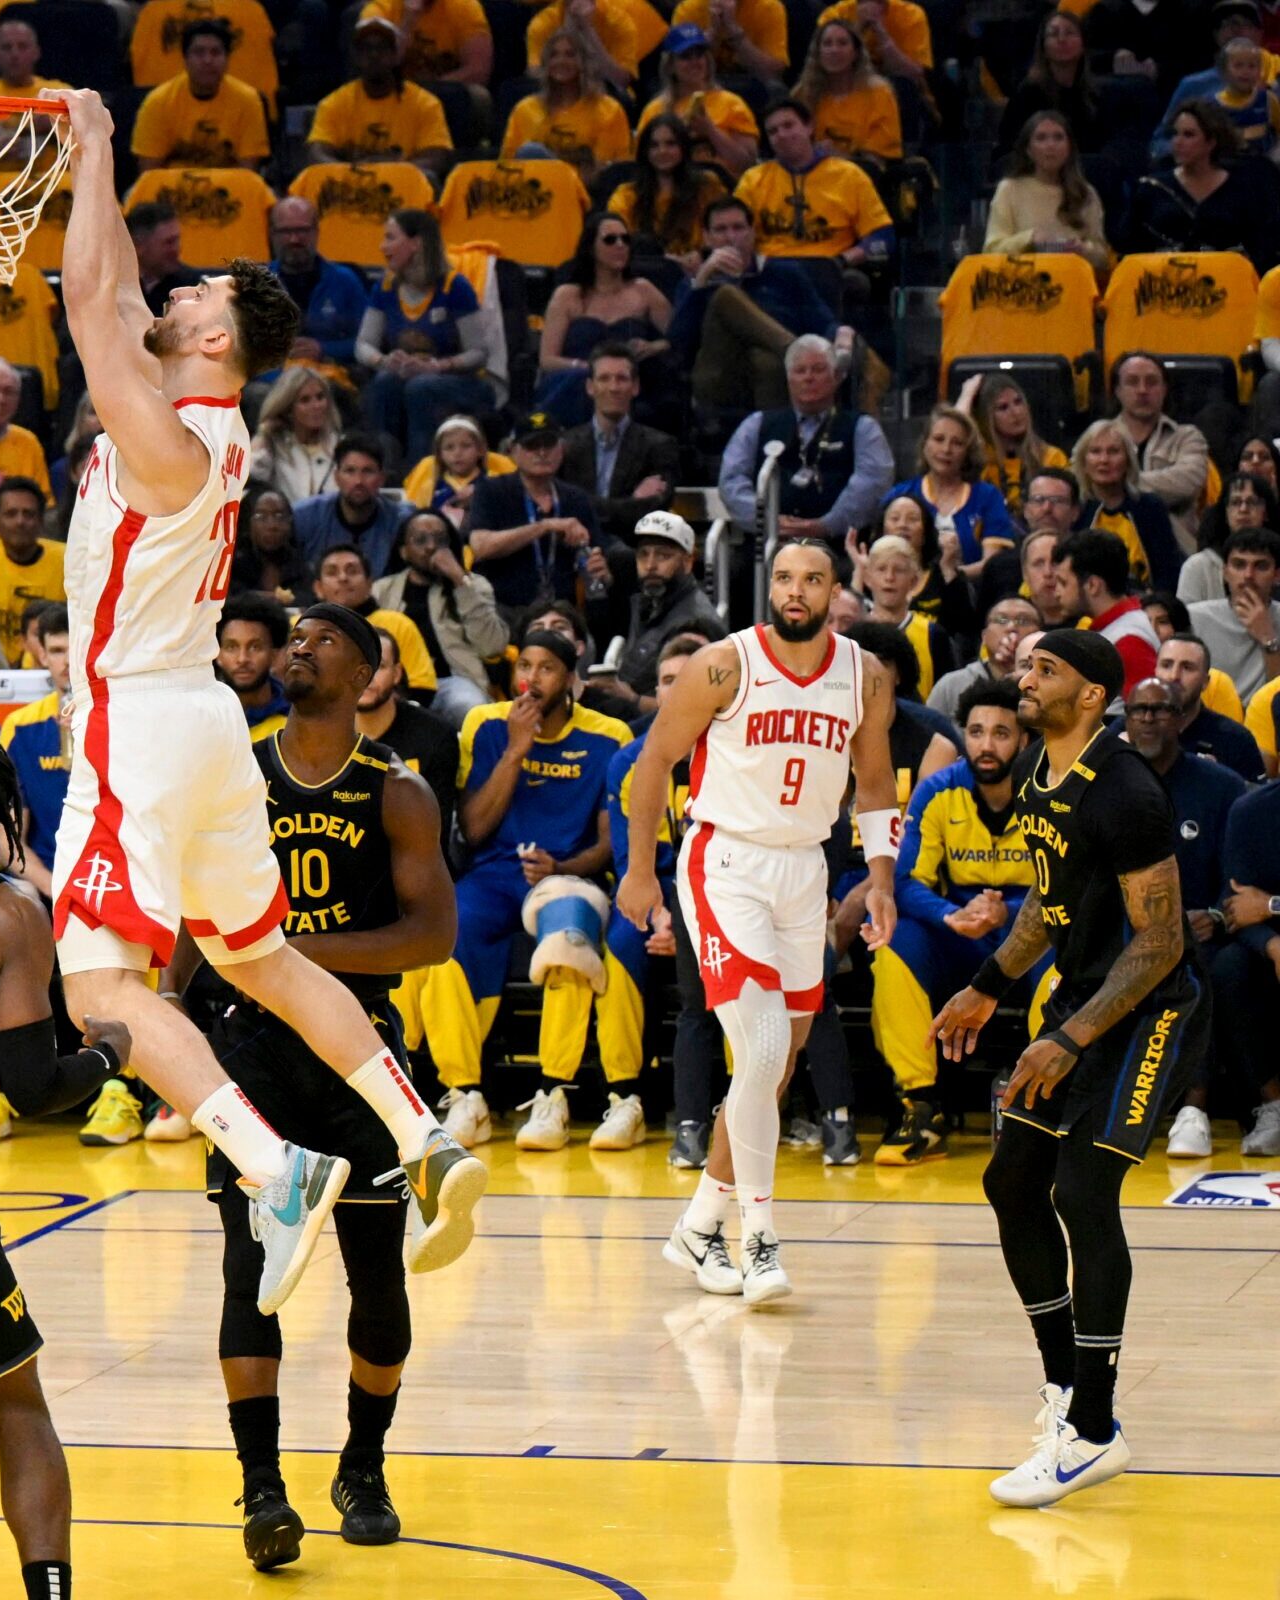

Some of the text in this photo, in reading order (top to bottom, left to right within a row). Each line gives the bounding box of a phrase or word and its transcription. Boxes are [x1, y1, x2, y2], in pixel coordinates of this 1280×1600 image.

[746, 709, 850, 754] ROCKETS
[332, 790, 371, 803] Rakuten
[780, 758, 806, 806] 9
[1020, 814, 1069, 858] OLDEN
[290, 848, 330, 898] 10
[285, 901, 351, 933] TATE
[1041, 905, 1071, 926] ATE
[1126, 1009, 1179, 1125] WARRIORS
[1186, 1197, 1253, 1206] NBA
